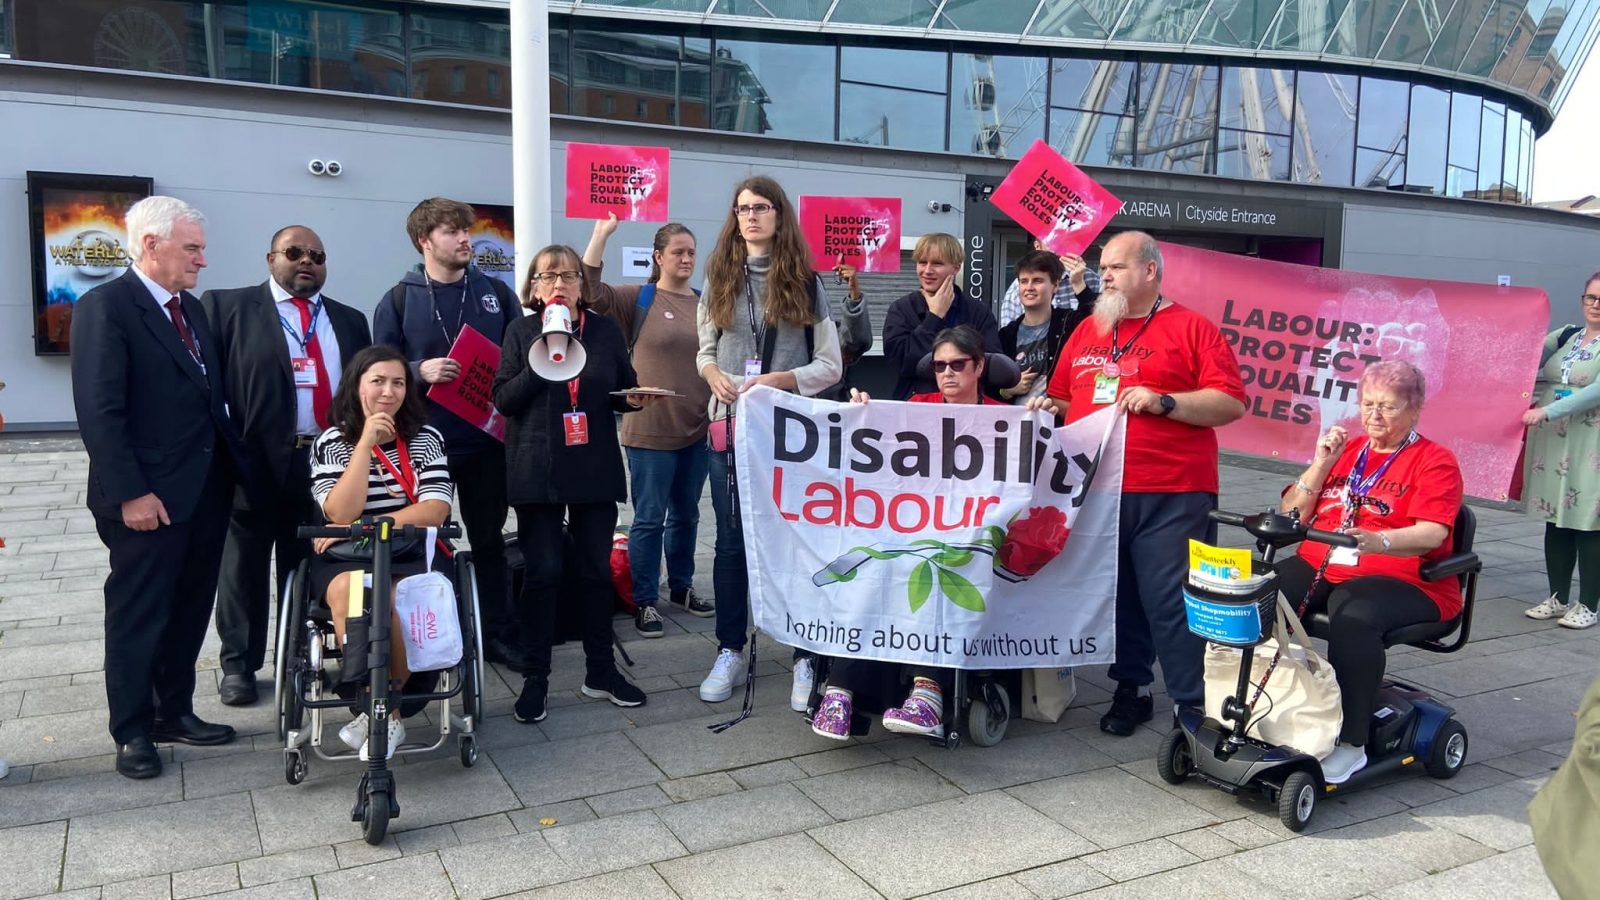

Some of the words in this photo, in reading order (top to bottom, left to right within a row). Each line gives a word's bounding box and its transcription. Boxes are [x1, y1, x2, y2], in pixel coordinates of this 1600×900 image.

[591, 162, 641, 174] LABOUR:
[591, 173, 645, 185] PROTECT
[590, 183, 646, 196] EQUALITY
[590, 194, 627, 205] ROLES
[1033, 179, 1082, 217] PROTECT
[1040, 169, 1085, 208] LABOUR:
[825, 214, 875, 225] LABOUR:
[1019, 197, 1053, 225] ROLES
[1026, 188, 1076, 228] EQUALITY
[1129, 202, 1171, 218] ARENA
[1185, 204, 1228, 223] Cityside
[1231, 208, 1276, 225] Entrance
[825, 225, 878, 235] PROTECT
[825, 235, 880, 246] EQUALITY
[50, 245, 131, 260] WATERLO
[825, 246, 860, 256] ROLES
[970, 235, 984, 300] come
[1222, 299, 1374, 346] LABOUR:
[1220, 328, 1381, 373] PROTECT
[1237, 364, 1357, 402] QUALIT
[457, 386, 490, 412] ROLES
[773, 405, 1103, 508] Disability
[772, 466, 1000, 534] Labour
[1201, 605, 1252, 617] Shopmobility
[872, 625, 952, 656] about
[980, 632, 1059, 656] without
[1070, 634, 1097, 655] us
